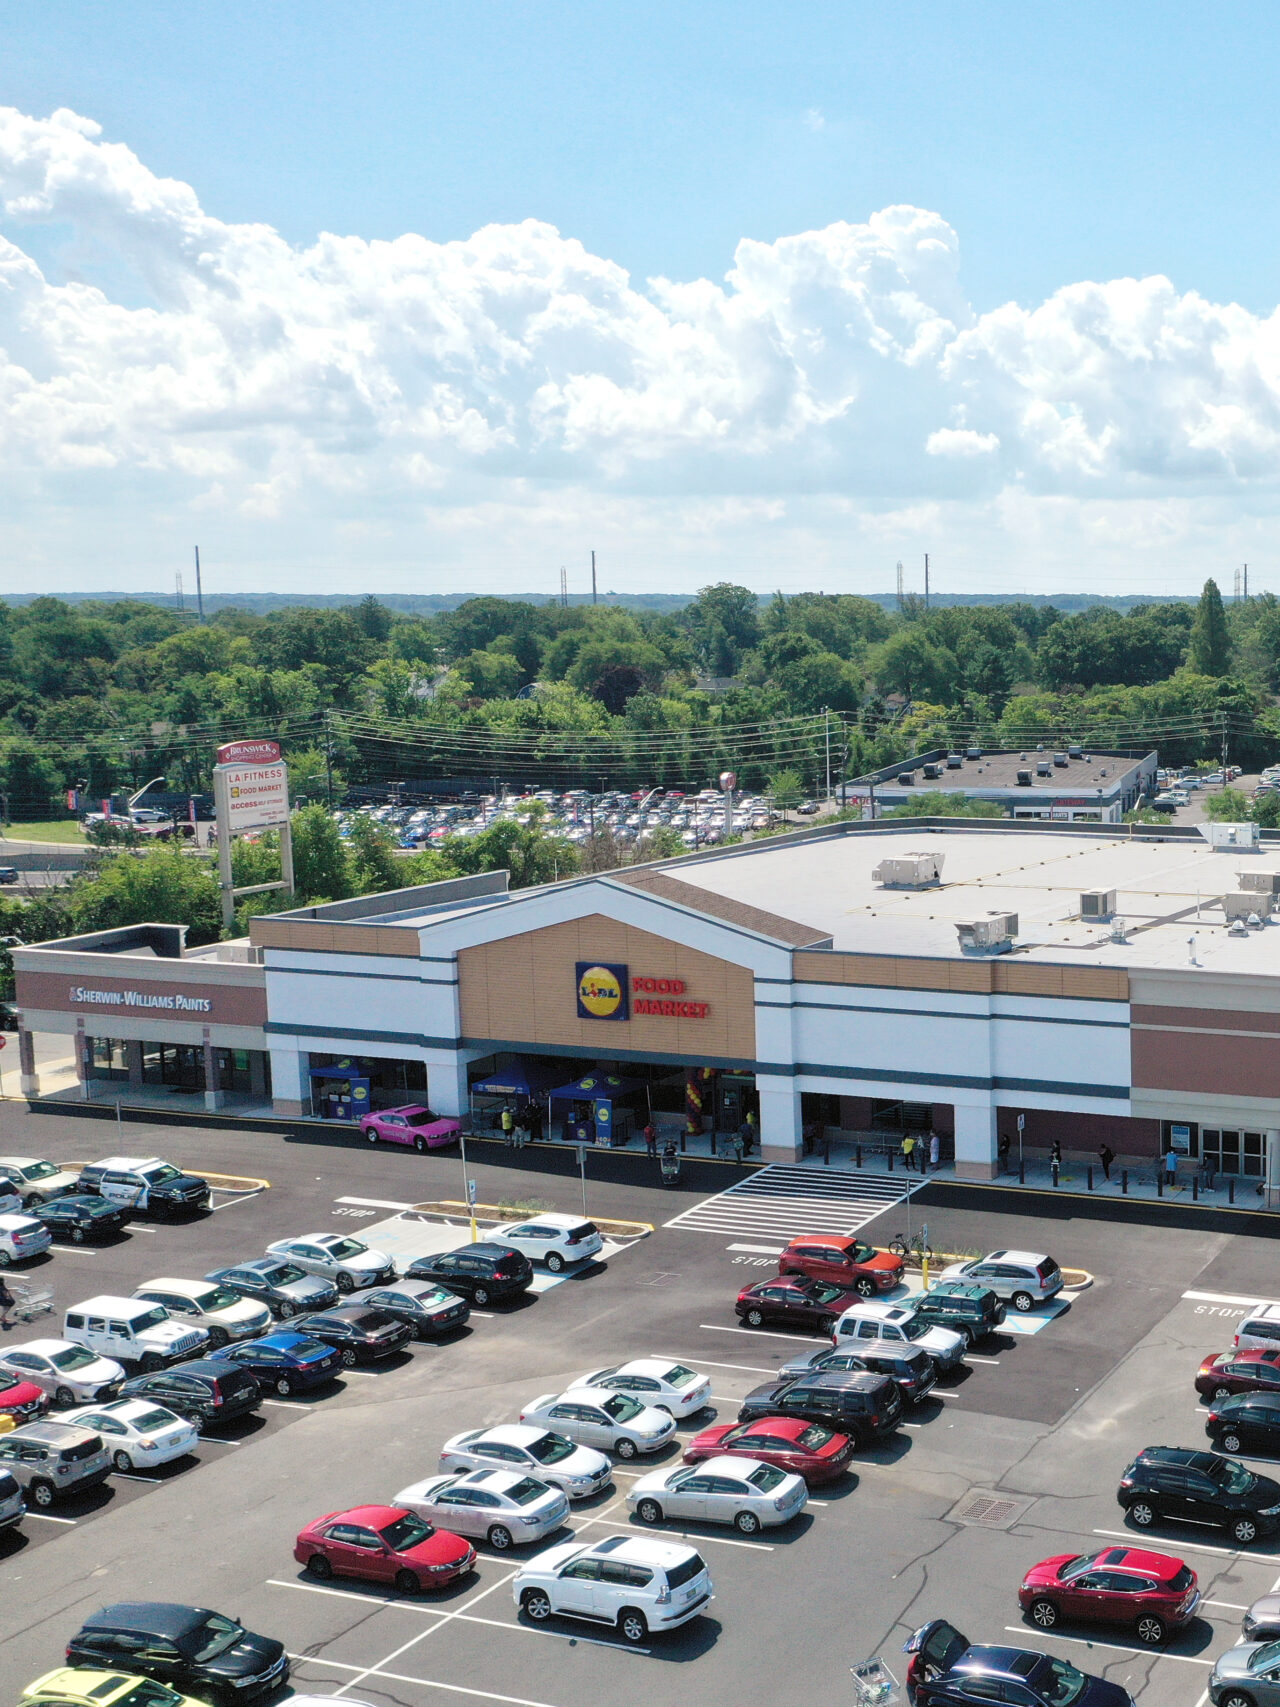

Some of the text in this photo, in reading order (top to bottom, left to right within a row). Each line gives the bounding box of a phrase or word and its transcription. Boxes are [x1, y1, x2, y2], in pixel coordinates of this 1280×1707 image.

[230, 743, 271, 755] BRUNSWICK
[229, 769, 282, 783] LA FITNESS
[240, 786, 257, 795] FOOD
[258, 784, 282, 793] MARKET
[632, 977, 685, 996] FOOD
[175, 994, 211, 1012] PAINTS
[633, 998, 708, 1019] MARKET
[331, 1207, 377, 1218] STOP
[731, 1256, 779, 1267] STOP
[1193, 1305, 1245, 1318] STOP
